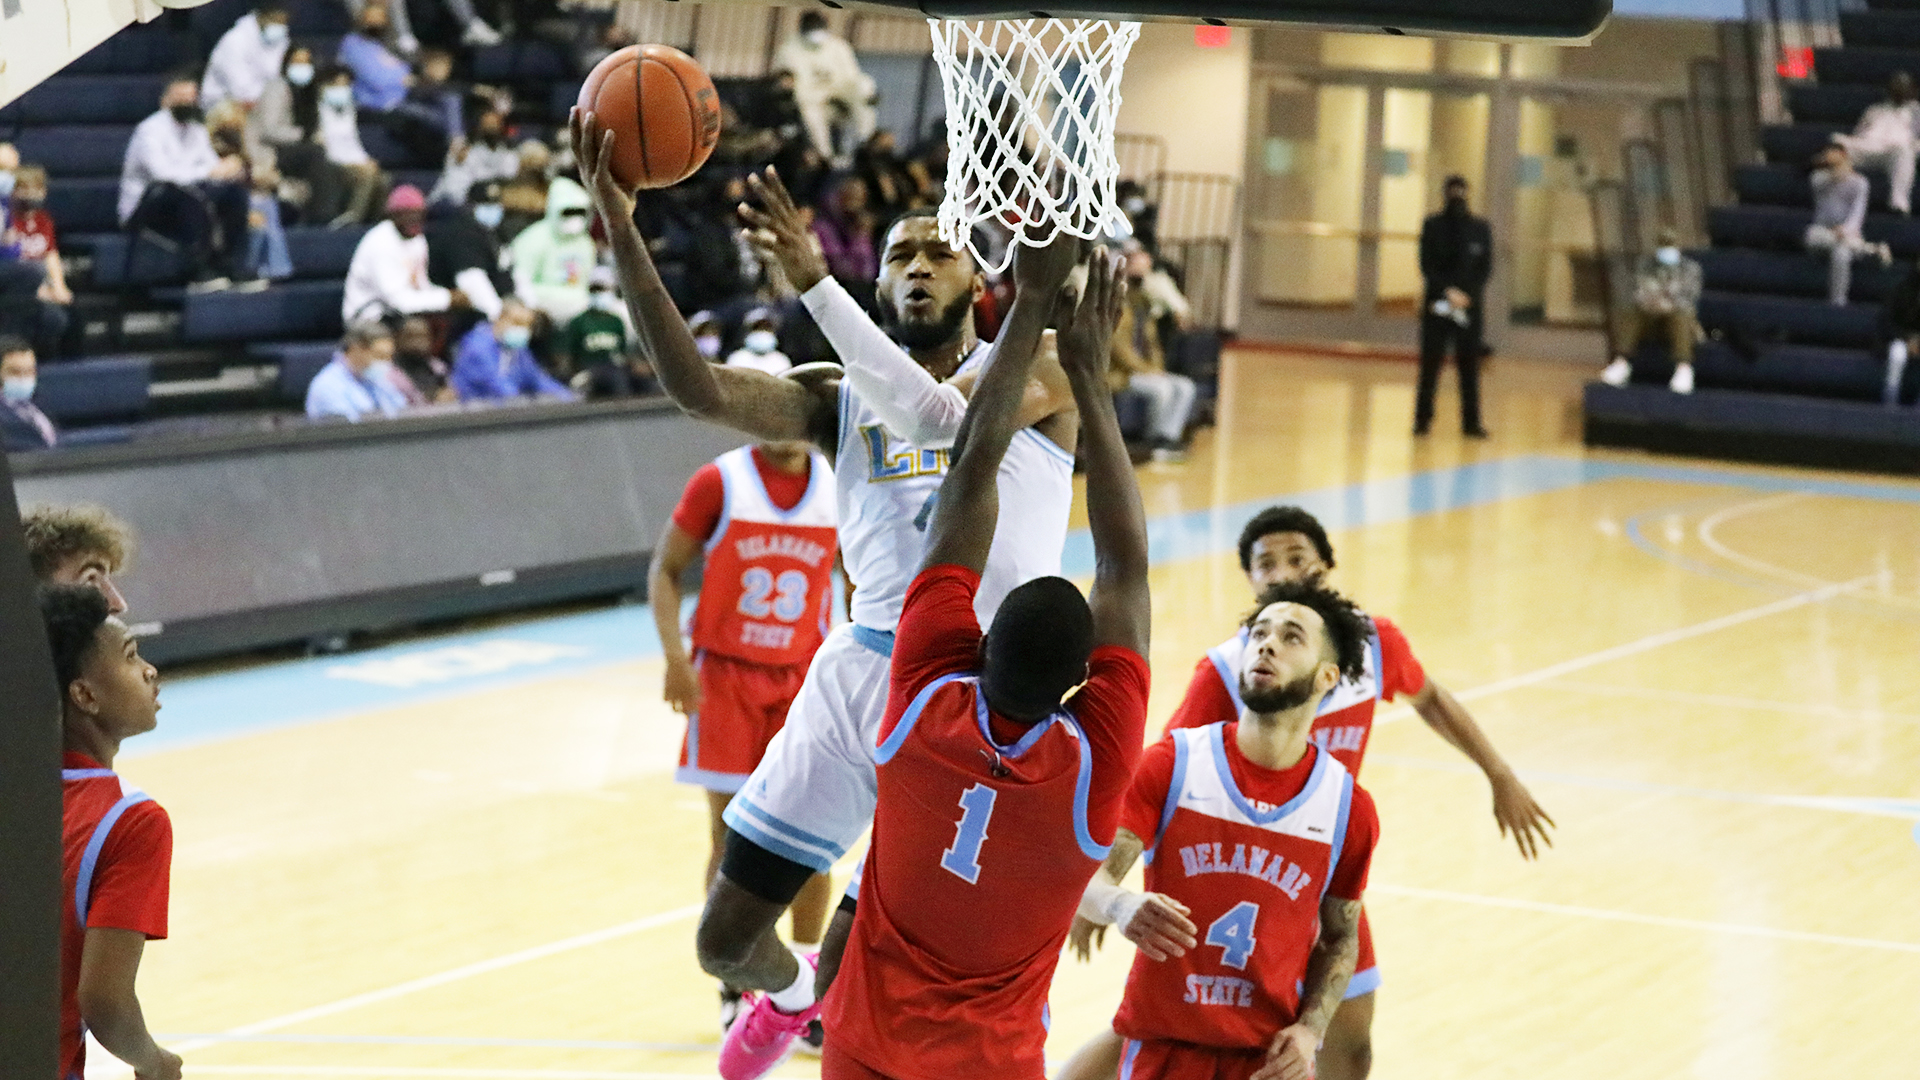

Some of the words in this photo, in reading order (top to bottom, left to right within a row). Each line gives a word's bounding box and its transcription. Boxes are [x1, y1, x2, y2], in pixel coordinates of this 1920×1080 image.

[858, 423, 951, 484] LI
[735, 533, 827, 568] DELAWARE
[737, 566, 810, 623] 23
[741, 621, 796, 650] STATE
[941, 782, 997, 885] 1
[1179, 842, 1312, 901] DELAWARE
[1205, 901, 1260, 971] 4
[1183, 973, 1255, 1008] STATE
